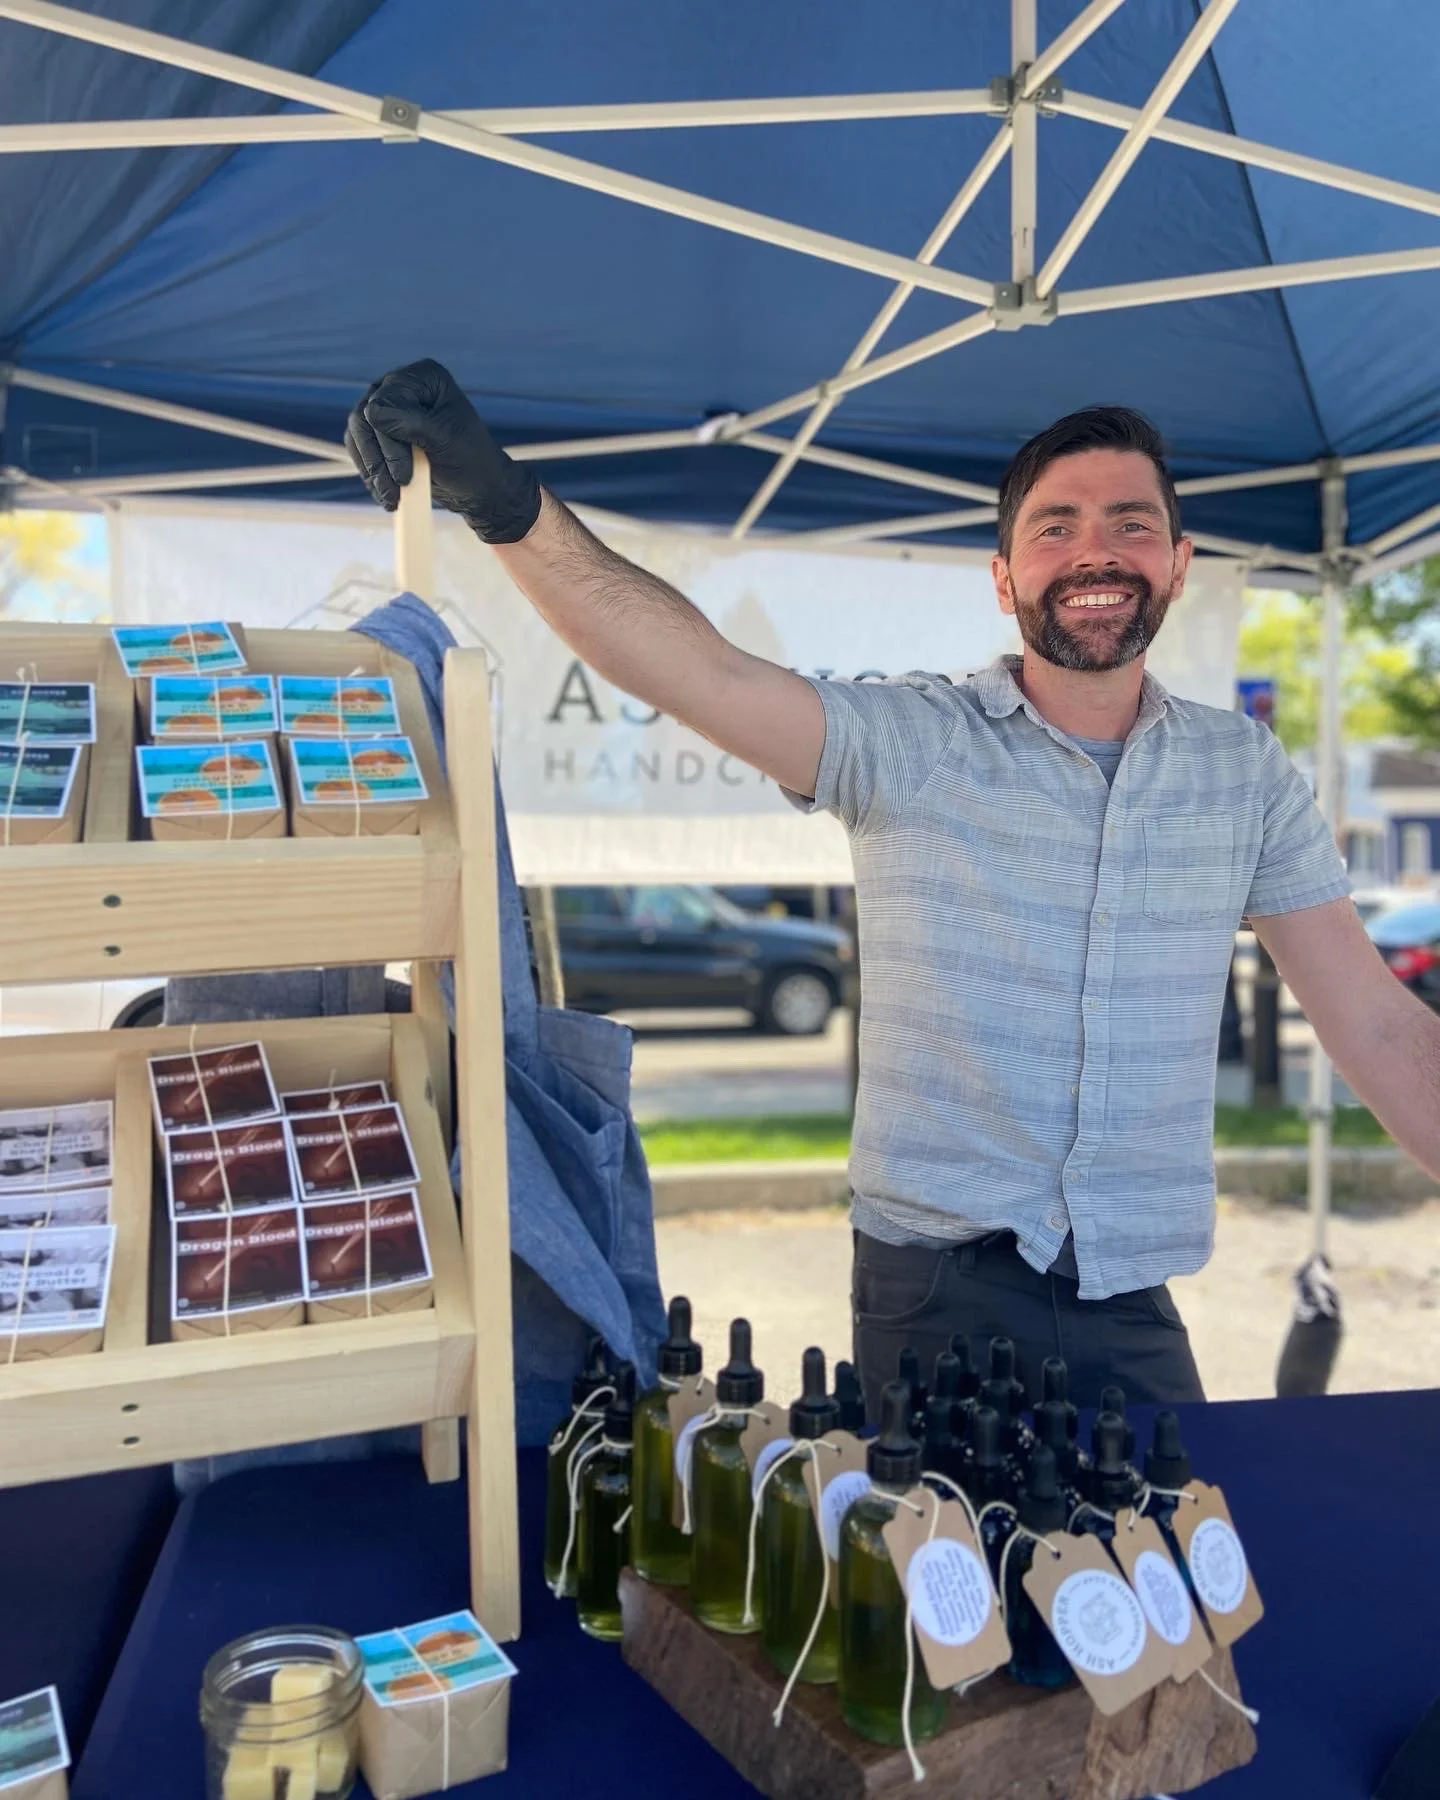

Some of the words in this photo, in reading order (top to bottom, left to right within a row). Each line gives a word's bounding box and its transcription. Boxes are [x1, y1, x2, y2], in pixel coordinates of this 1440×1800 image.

[543, 749, 767, 786] HANDC
[238, 1138, 284, 1156] Blood
[248, 1227, 297, 1246] Blood
[304, 1222, 365, 1238] Dragon
[1056, 1595, 1084, 1657] HOPPER
[1086, 1650, 1115, 1671] ASH
